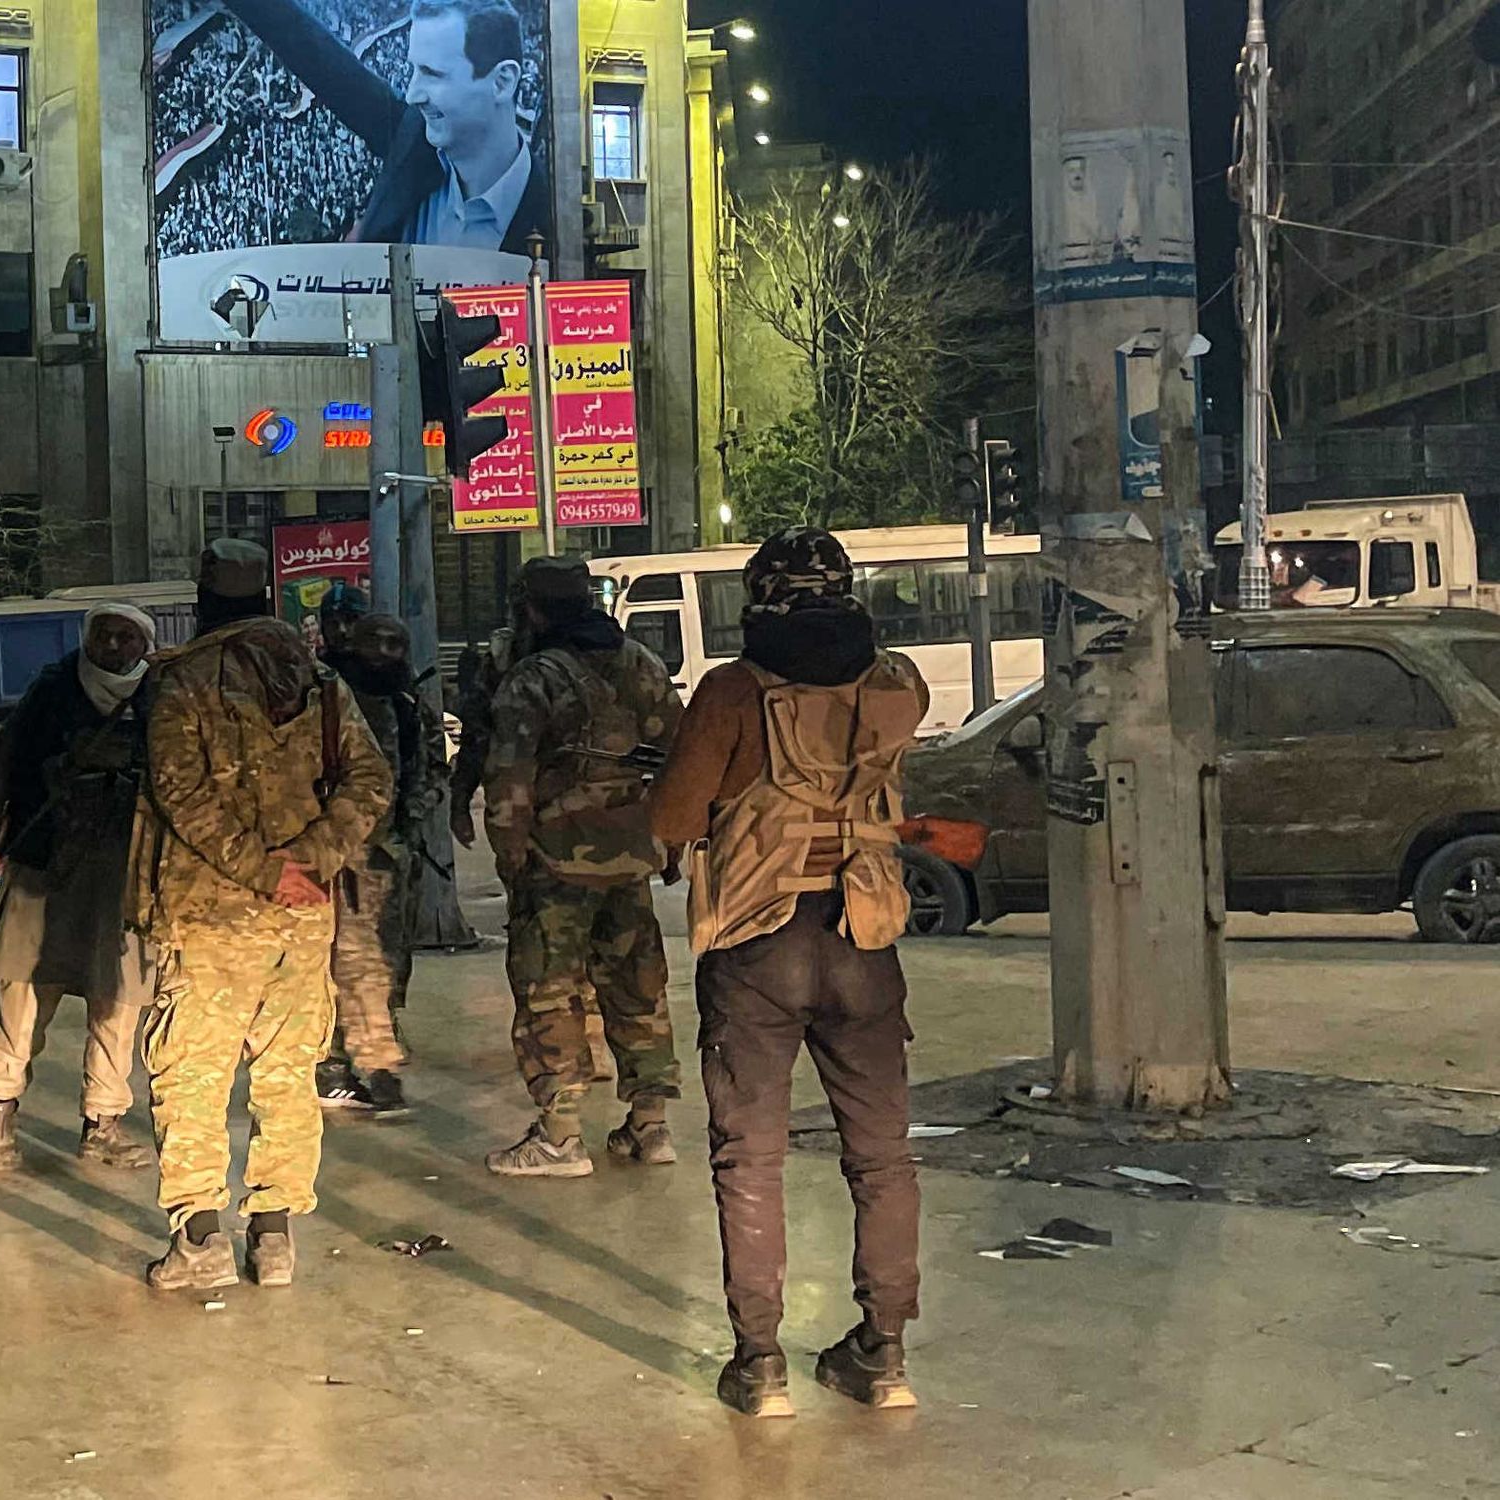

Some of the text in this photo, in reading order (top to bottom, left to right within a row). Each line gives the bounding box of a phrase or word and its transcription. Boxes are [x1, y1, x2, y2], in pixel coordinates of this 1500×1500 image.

[562, 318, 615, 340] مدرسة
[514, 343, 527, 368] 3
[551, 348, 631, 381] المميزون
[583, 394, 603, 418] في
[598, 422, 634, 440] مقرها
[617, 446, 634, 467] في
[469, 463, 523, 486] إعدادي
[469, 482, 523, 505] ثانوي
[560, 503, 635, 520] 0944557949
